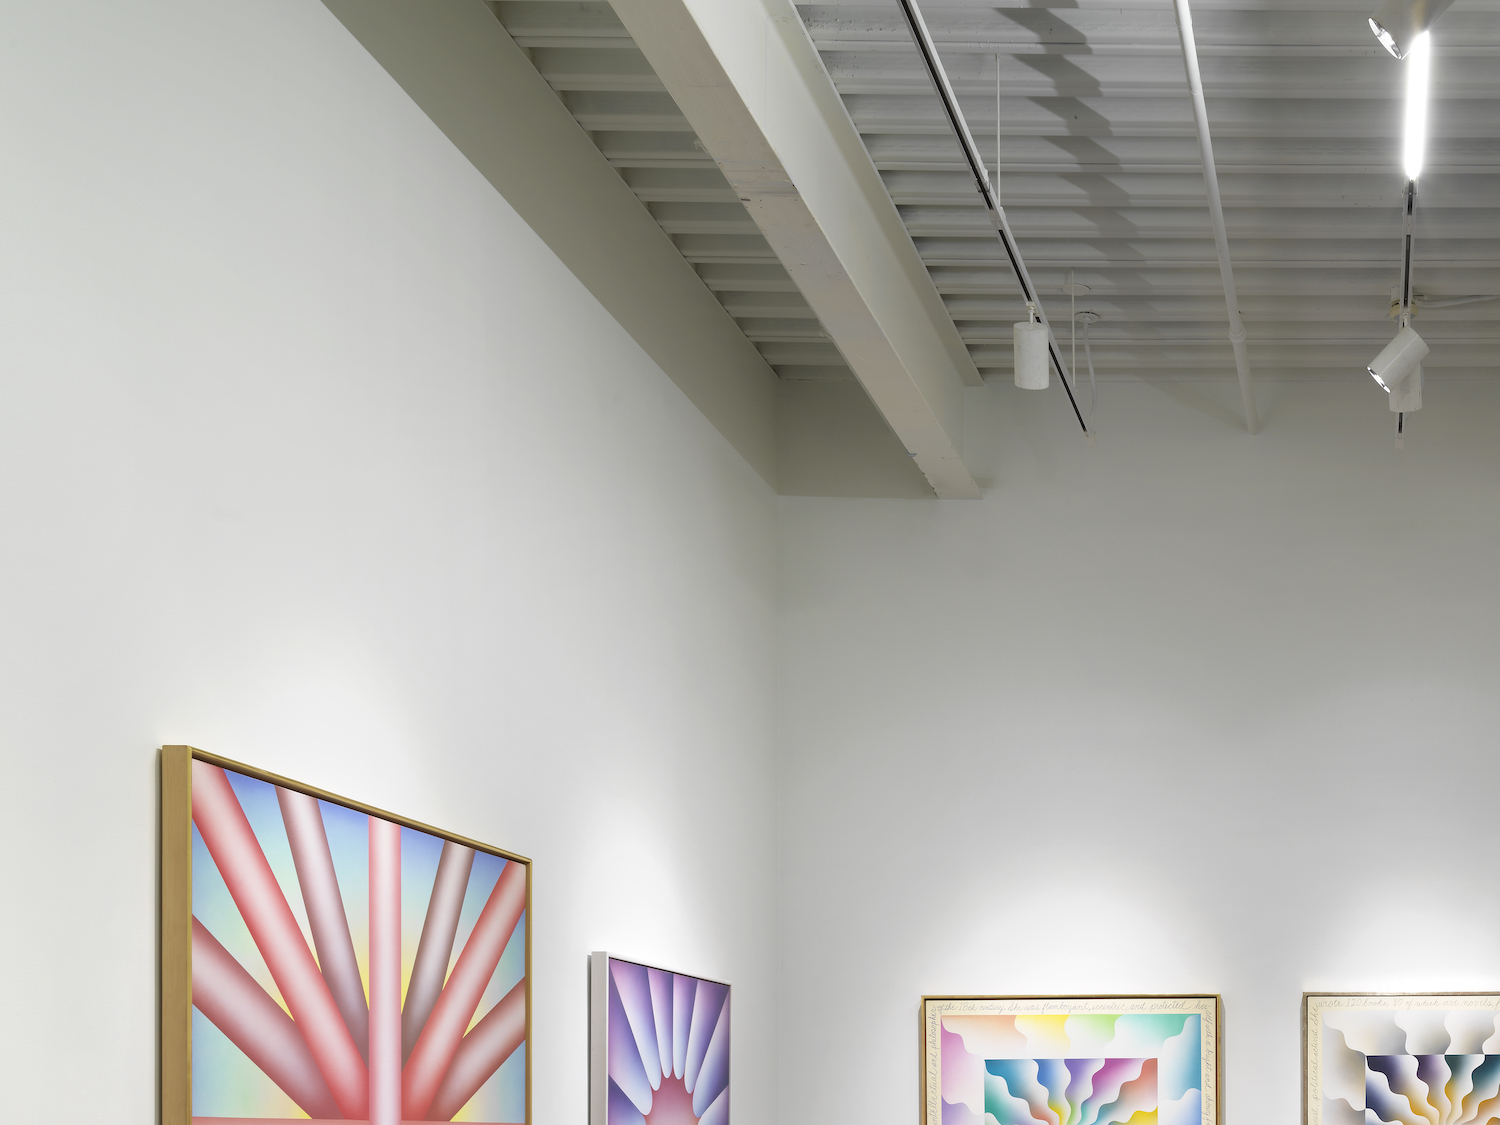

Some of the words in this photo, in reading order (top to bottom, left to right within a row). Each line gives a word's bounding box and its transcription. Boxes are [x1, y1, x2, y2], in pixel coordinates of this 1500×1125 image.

[958, 1002, 979, 1011] 18th
[1008, 1002, 1024, 1011] She
[1130, 1002, 1147, 1010] and
[1148, 1001, 1191, 1012] protected
[1310, 1003, 1319, 1027] She
[1317, 999, 1345, 1007] wrote
[1346, 998, 1361, 1007] 120
[1393, 998, 1402, 1006] 80
[1406, 999, 1413, 1010] of
[1414, 999, 1440, 1007] which
[929, 1005, 940, 1050] philosopher
[1202, 1010, 1213, 1025] self
[1205, 1024, 1213, 1040] with
[1201, 1048, 1213, 1073] bright
[1310, 1059, 1320, 1102] political
[1202, 1093, 1214, 1116] showy
